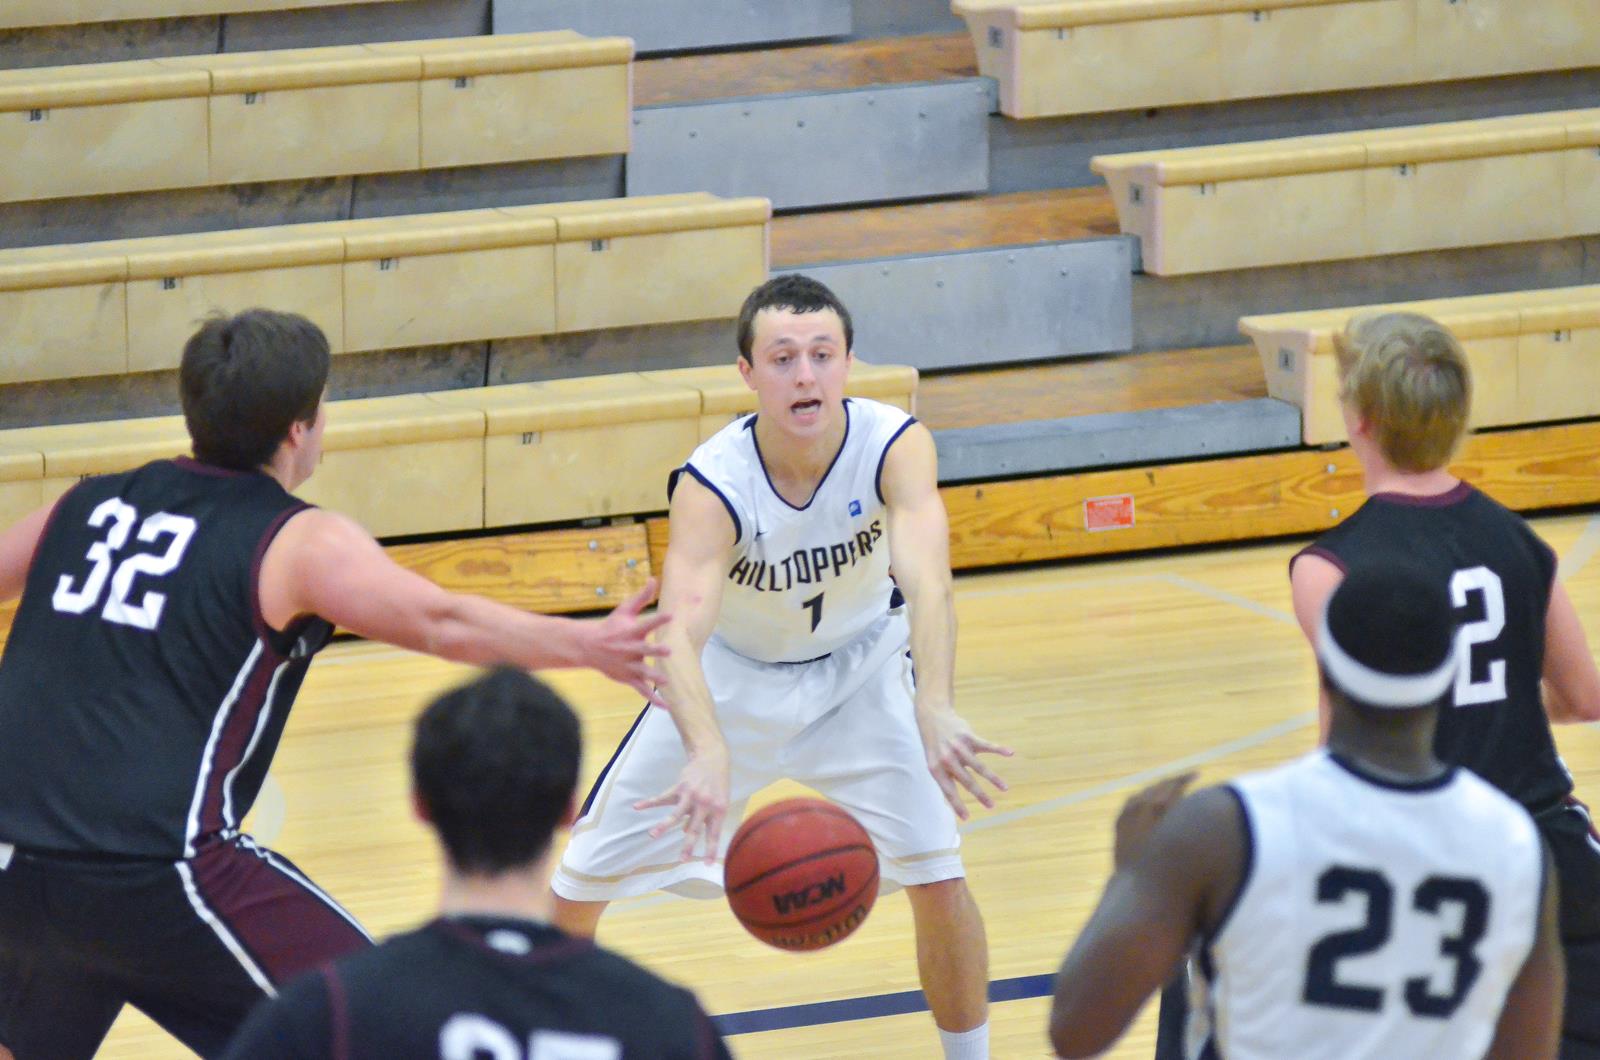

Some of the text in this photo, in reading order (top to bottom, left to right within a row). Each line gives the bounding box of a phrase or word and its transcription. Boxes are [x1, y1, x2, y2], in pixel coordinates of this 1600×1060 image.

[52, 497, 197, 630] 32
[728, 519, 882, 592] HILLTOPPERS
[802, 592, 825, 633] 1
[1450, 566, 1507, 706] 2
[773, 871, 846, 915] NCAA
[1302, 865, 1492, 1019] 23
